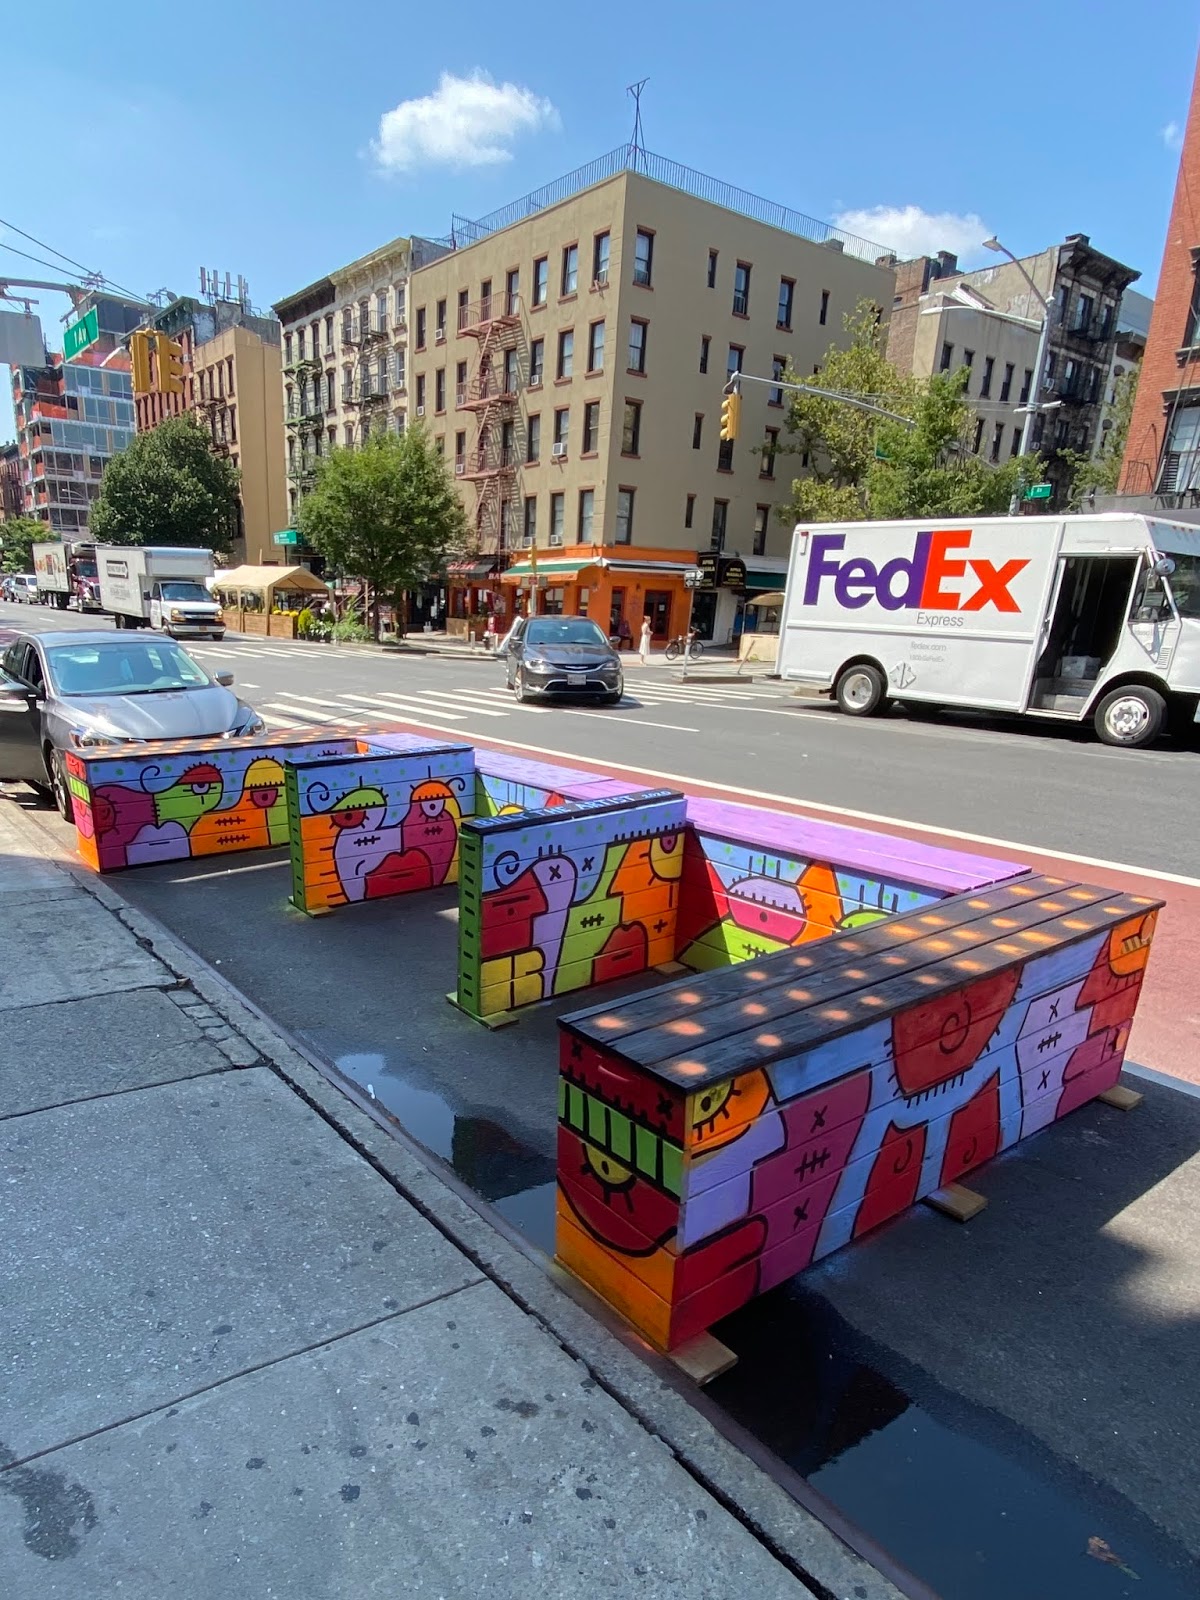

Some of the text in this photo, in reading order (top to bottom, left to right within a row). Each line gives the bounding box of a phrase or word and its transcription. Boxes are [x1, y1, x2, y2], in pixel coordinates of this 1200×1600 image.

[803, 529, 1032, 613] FedEx
[916, 611, 964, 628] Express
[474, 790, 672, 826] BILLY THE ARTIST 2020
